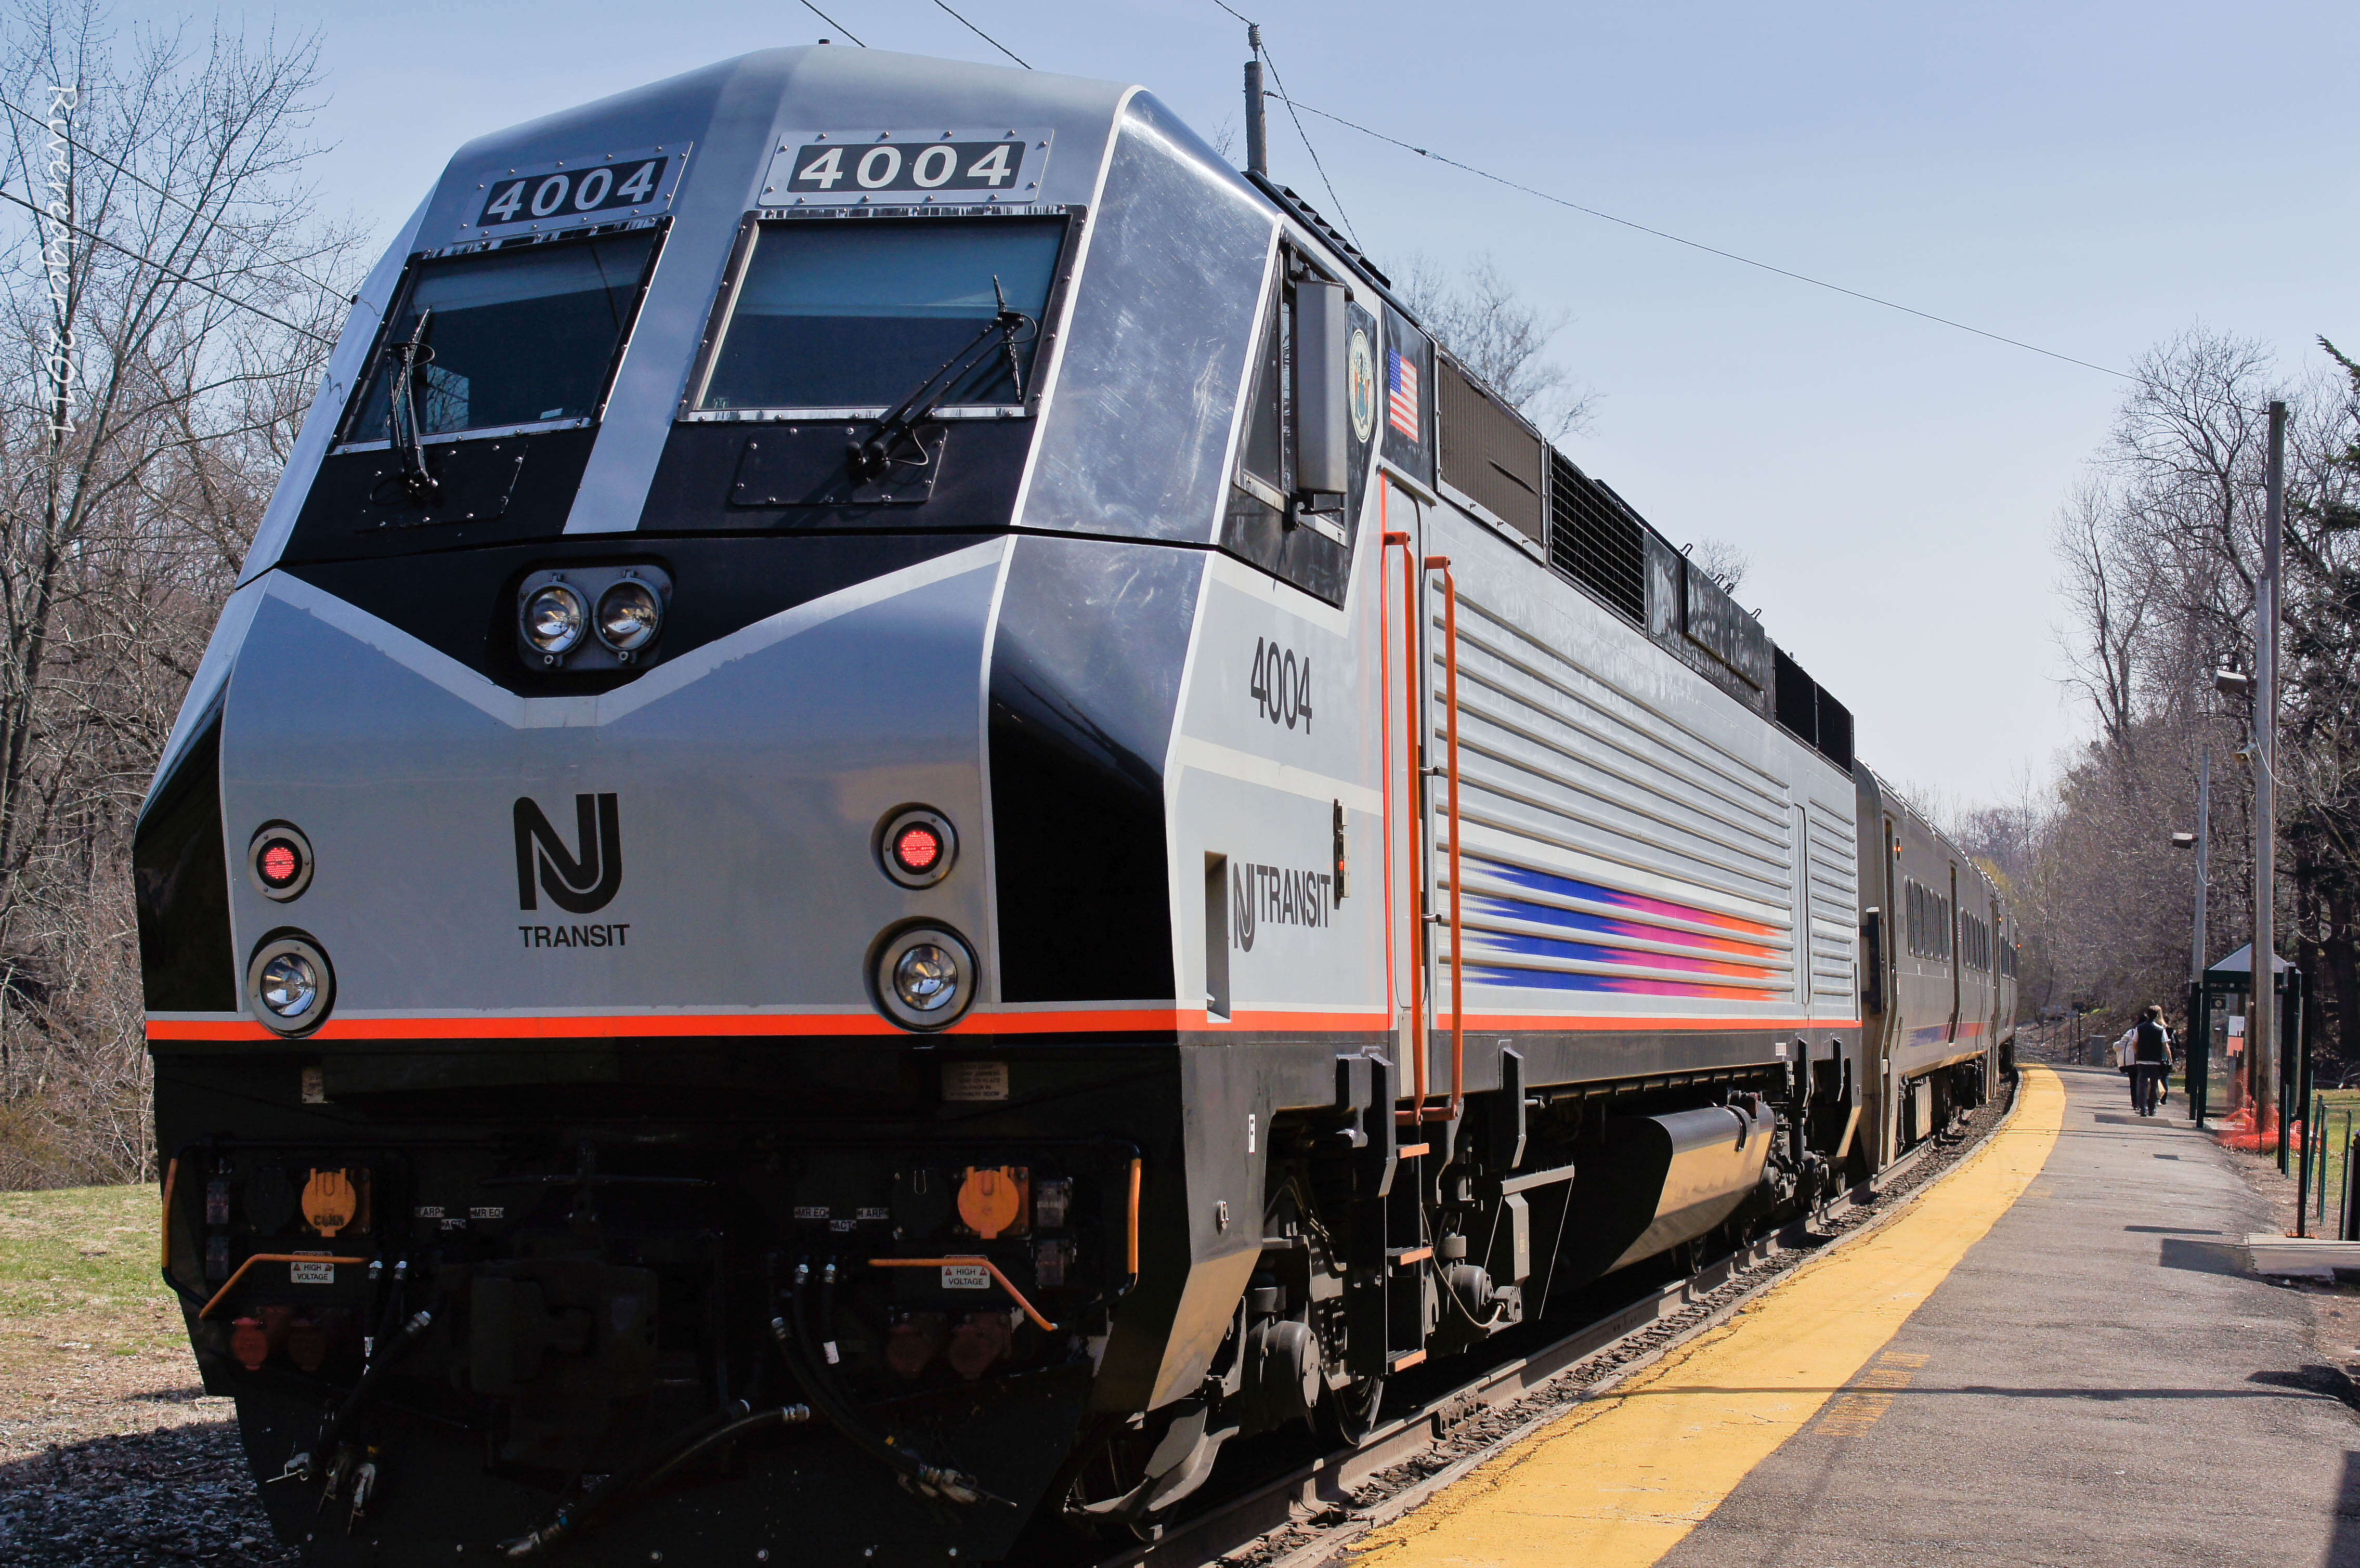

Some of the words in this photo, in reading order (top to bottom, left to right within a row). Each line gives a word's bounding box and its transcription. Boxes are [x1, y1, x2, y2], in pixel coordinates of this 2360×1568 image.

[487, 161, 657, 221] 4004
[799, 145, 1011, 189] 4004
[1250, 636, 1312, 735] 4004
[513, 793, 622, 914] NJ
[518, 924, 630, 948] TRANSIT
[1233, 862, 1255, 952] NJ
[1257, 864, 1331, 928] TRANSIT
[834, 1221, 852, 1230] ACT
